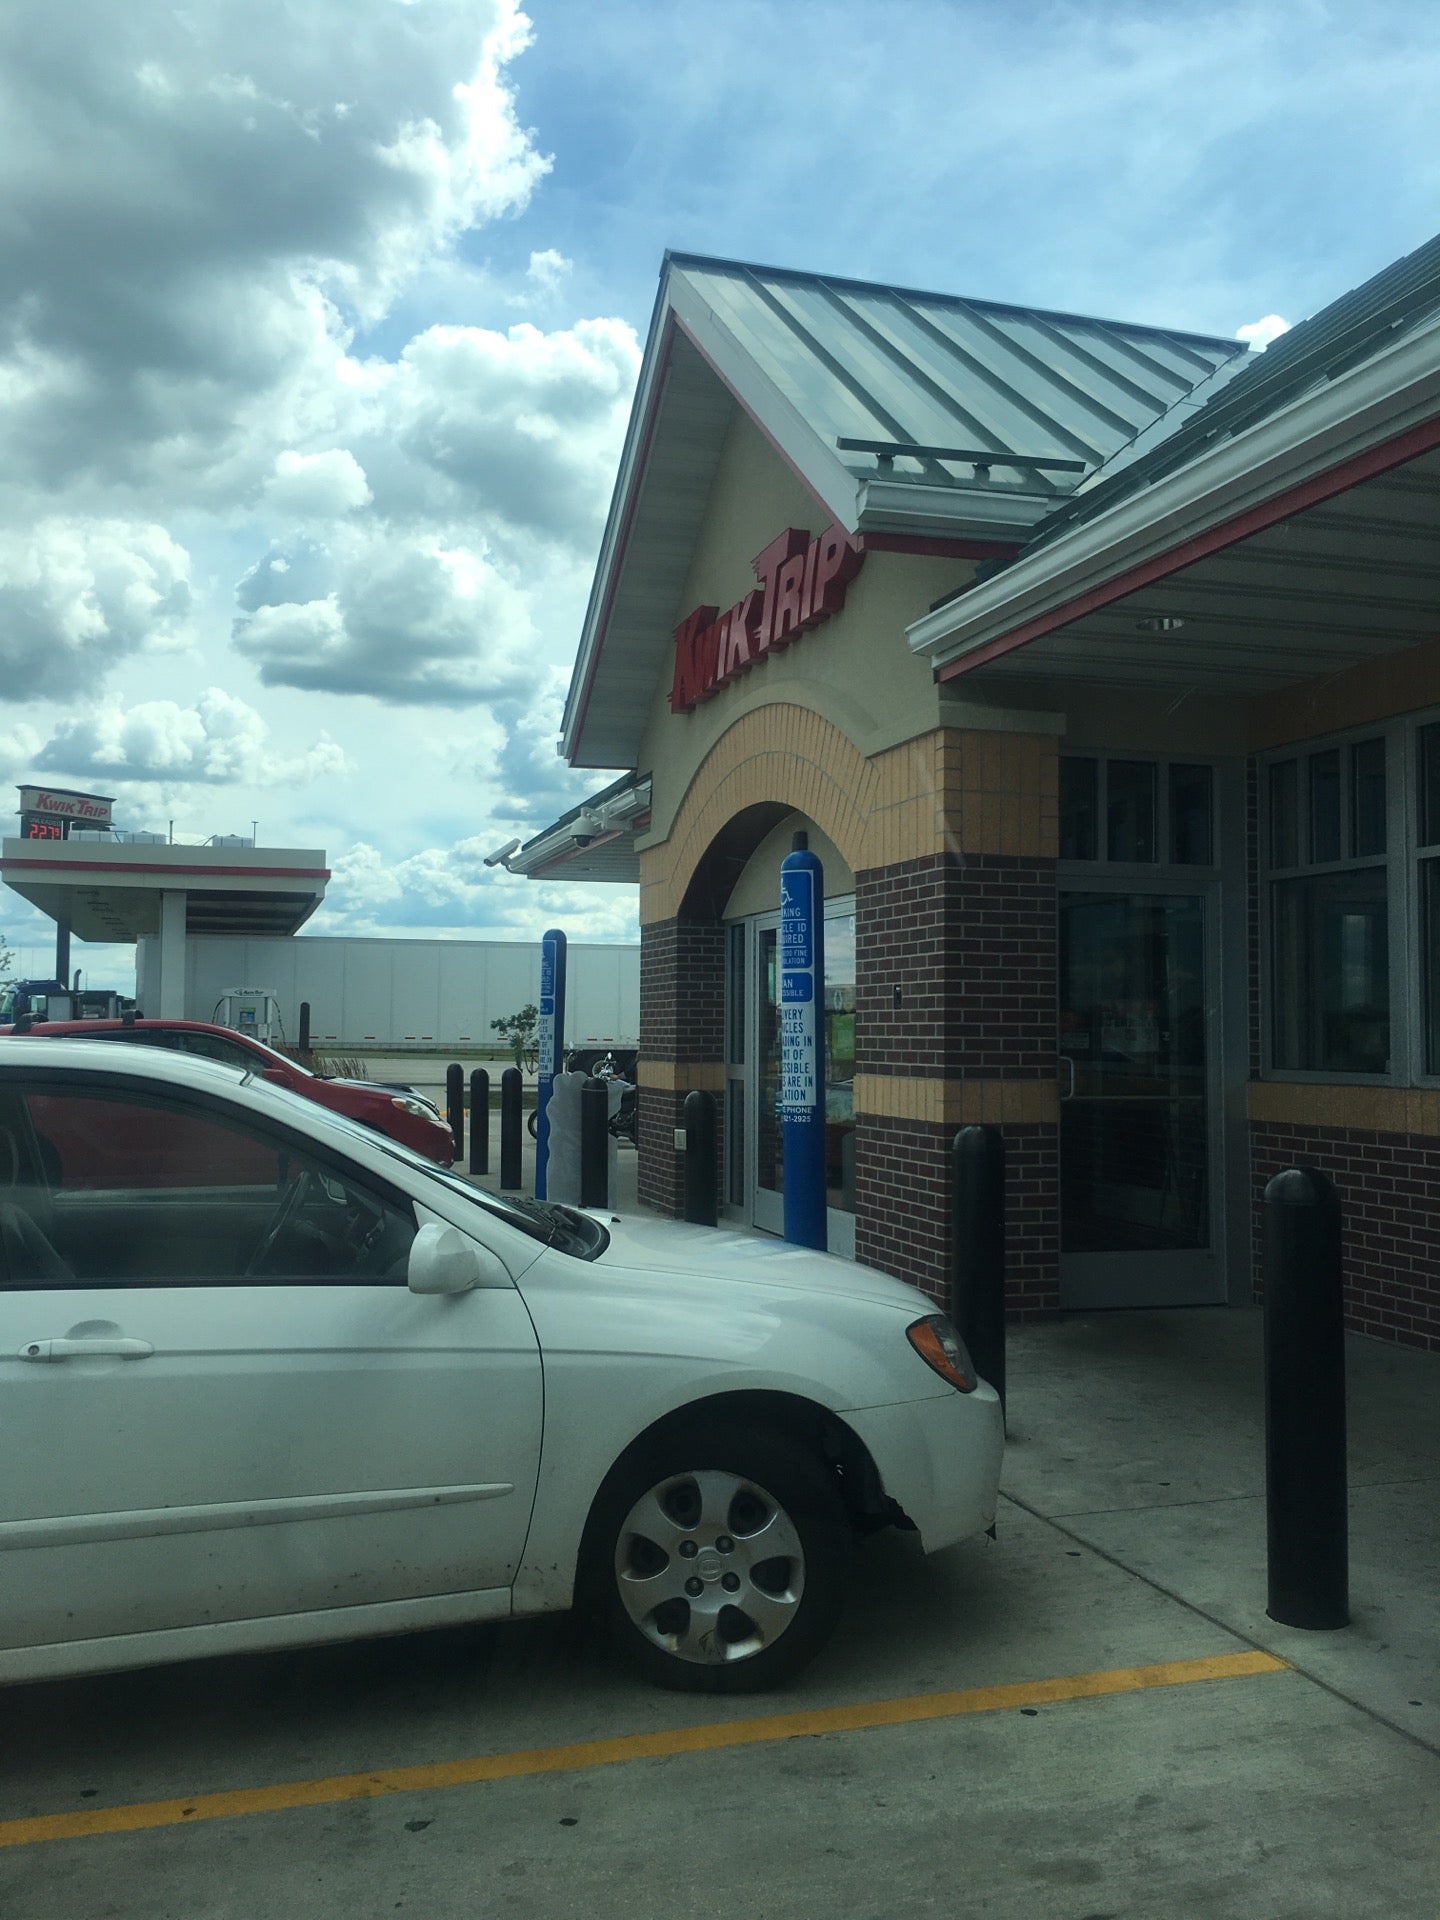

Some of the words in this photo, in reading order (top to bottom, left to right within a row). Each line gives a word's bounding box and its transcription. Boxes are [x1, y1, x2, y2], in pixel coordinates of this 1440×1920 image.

[751, 525, 860, 653] TRIP
[36, 793, 76, 813] KWIK
[77, 799, 108, 818] TRIP
[798, 922, 807, 933] ID
[804, 1036, 812, 1047] IN
[793, 1050, 804, 1060] OF
[787, 1076, 801, 1087] ARE
[805, 1076, 813, 1087] IN
